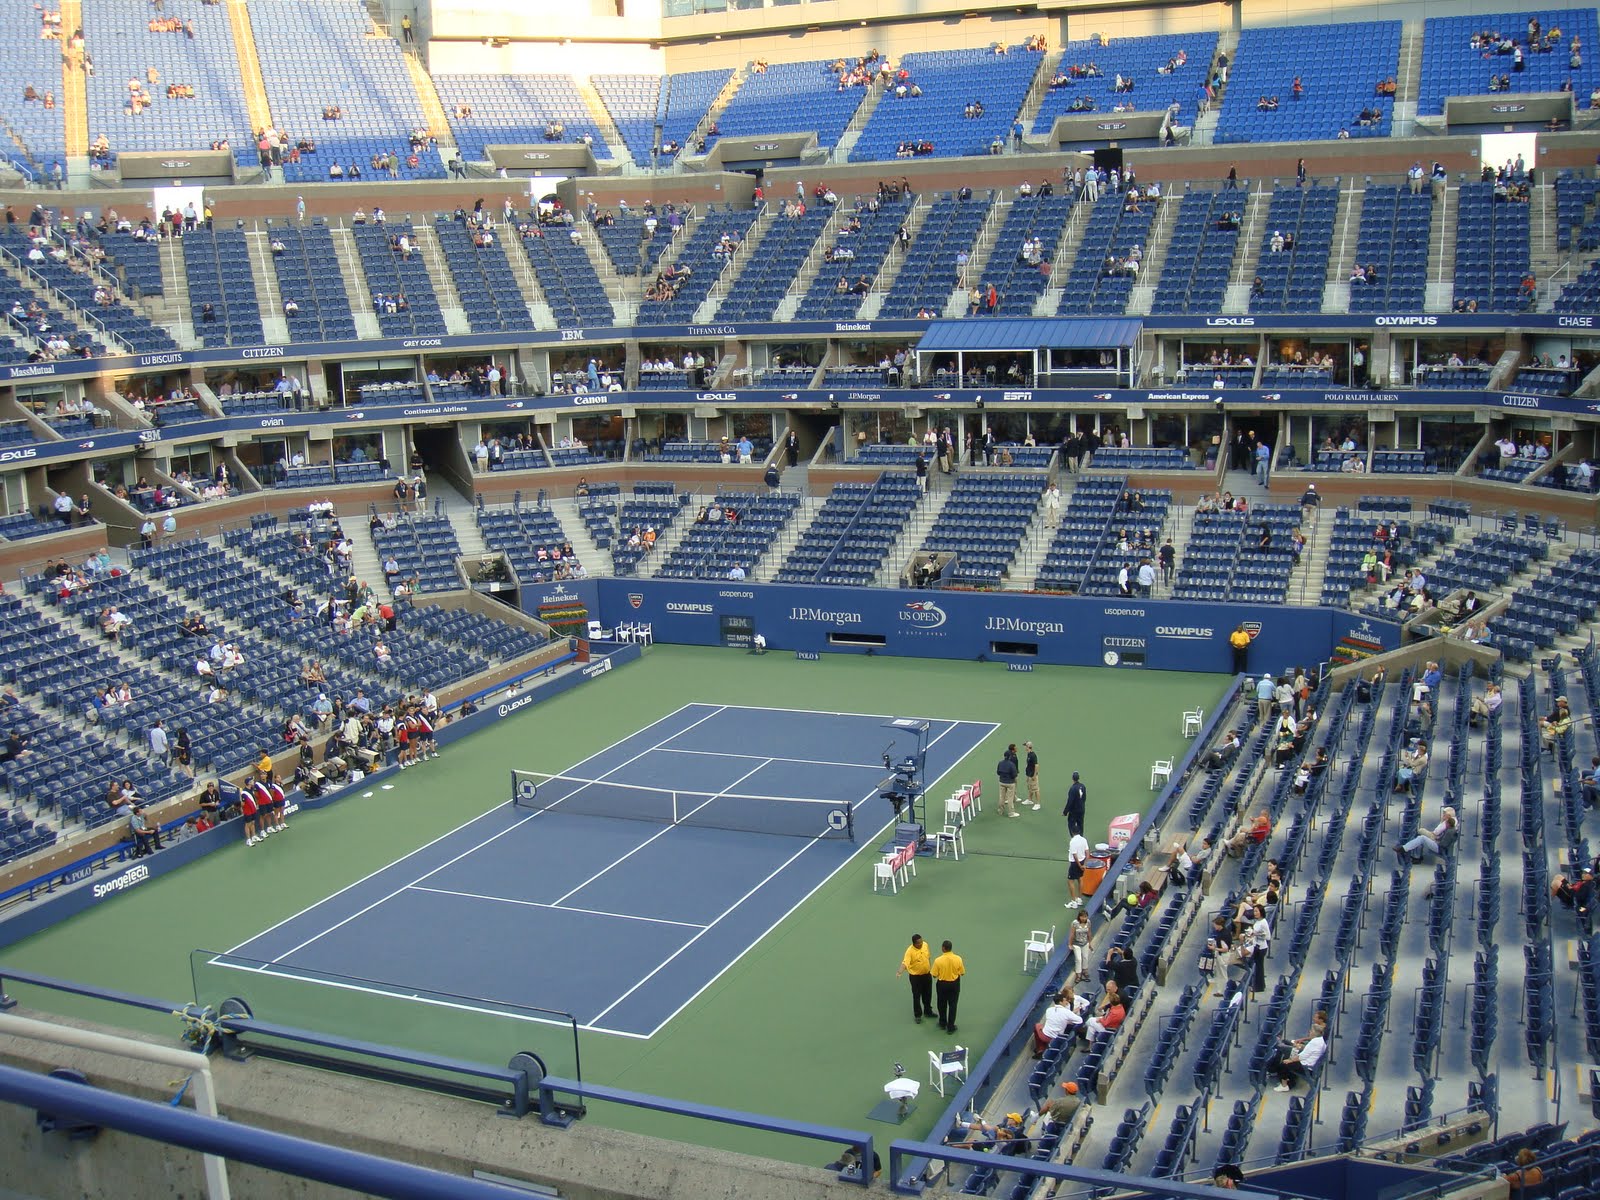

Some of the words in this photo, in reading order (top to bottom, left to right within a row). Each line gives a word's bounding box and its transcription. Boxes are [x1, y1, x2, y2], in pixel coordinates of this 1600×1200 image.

[835, 321, 871, 331] Heineken
[1206, 316, 1255, 326] LEXUS
[1375, 316, 1438, 326] OLYMPUS
[1558, 316, 1593, 327] CHASE
[561, 330, 584, 341] IBM
[420, 338, 442, 346] GOOSE
[242, 347, 284, 358] CITIZEN
[141, 356, 151, 365] LU
[151, 353, 183, 364] BISCUITS
[10, 364, 55, 378] MassMutual
[573, 395, 608, 406] Canon
[696, 392, 737, 401] LEXUS
[1003, 391, 1033, 401] ESPN
[1181, 393, 1210, 401] Express
[1324, 393, 1344, 401] POLO
[1502, 394, 1539, 408] CITIZEN
[403, 408, 441, 416] Continental
[261, 417, 284, 427] evian
[141, 429, 161, 441] IBM
[542, 594, 579, 603] Heineken
[719, 590, 754, 599] usopen.org
[666, 602, 713, 612] OLYMPUS
[1104, 607, 1145, 617] usopen.org
[899, 611, 911, 621] US
[912, 612, 940, 622] OPEN
[728, 617, 747, 627] IBM
[1155, 626, 1213, 637] OLYMPUS
[736, 634, 752, 642] MPH
[1103, 636, 1146, 648] CITIZEN
[1350, 629, 1381, 645] Heineken
[798, 652, 815, 660] POLO
[1010, 663, 1028, 671] POLO
[507, 695, 533, 711] LEXUS
[72, 866, 91, 881] POLO
[93, 864, 149, 898] SpongeTech
